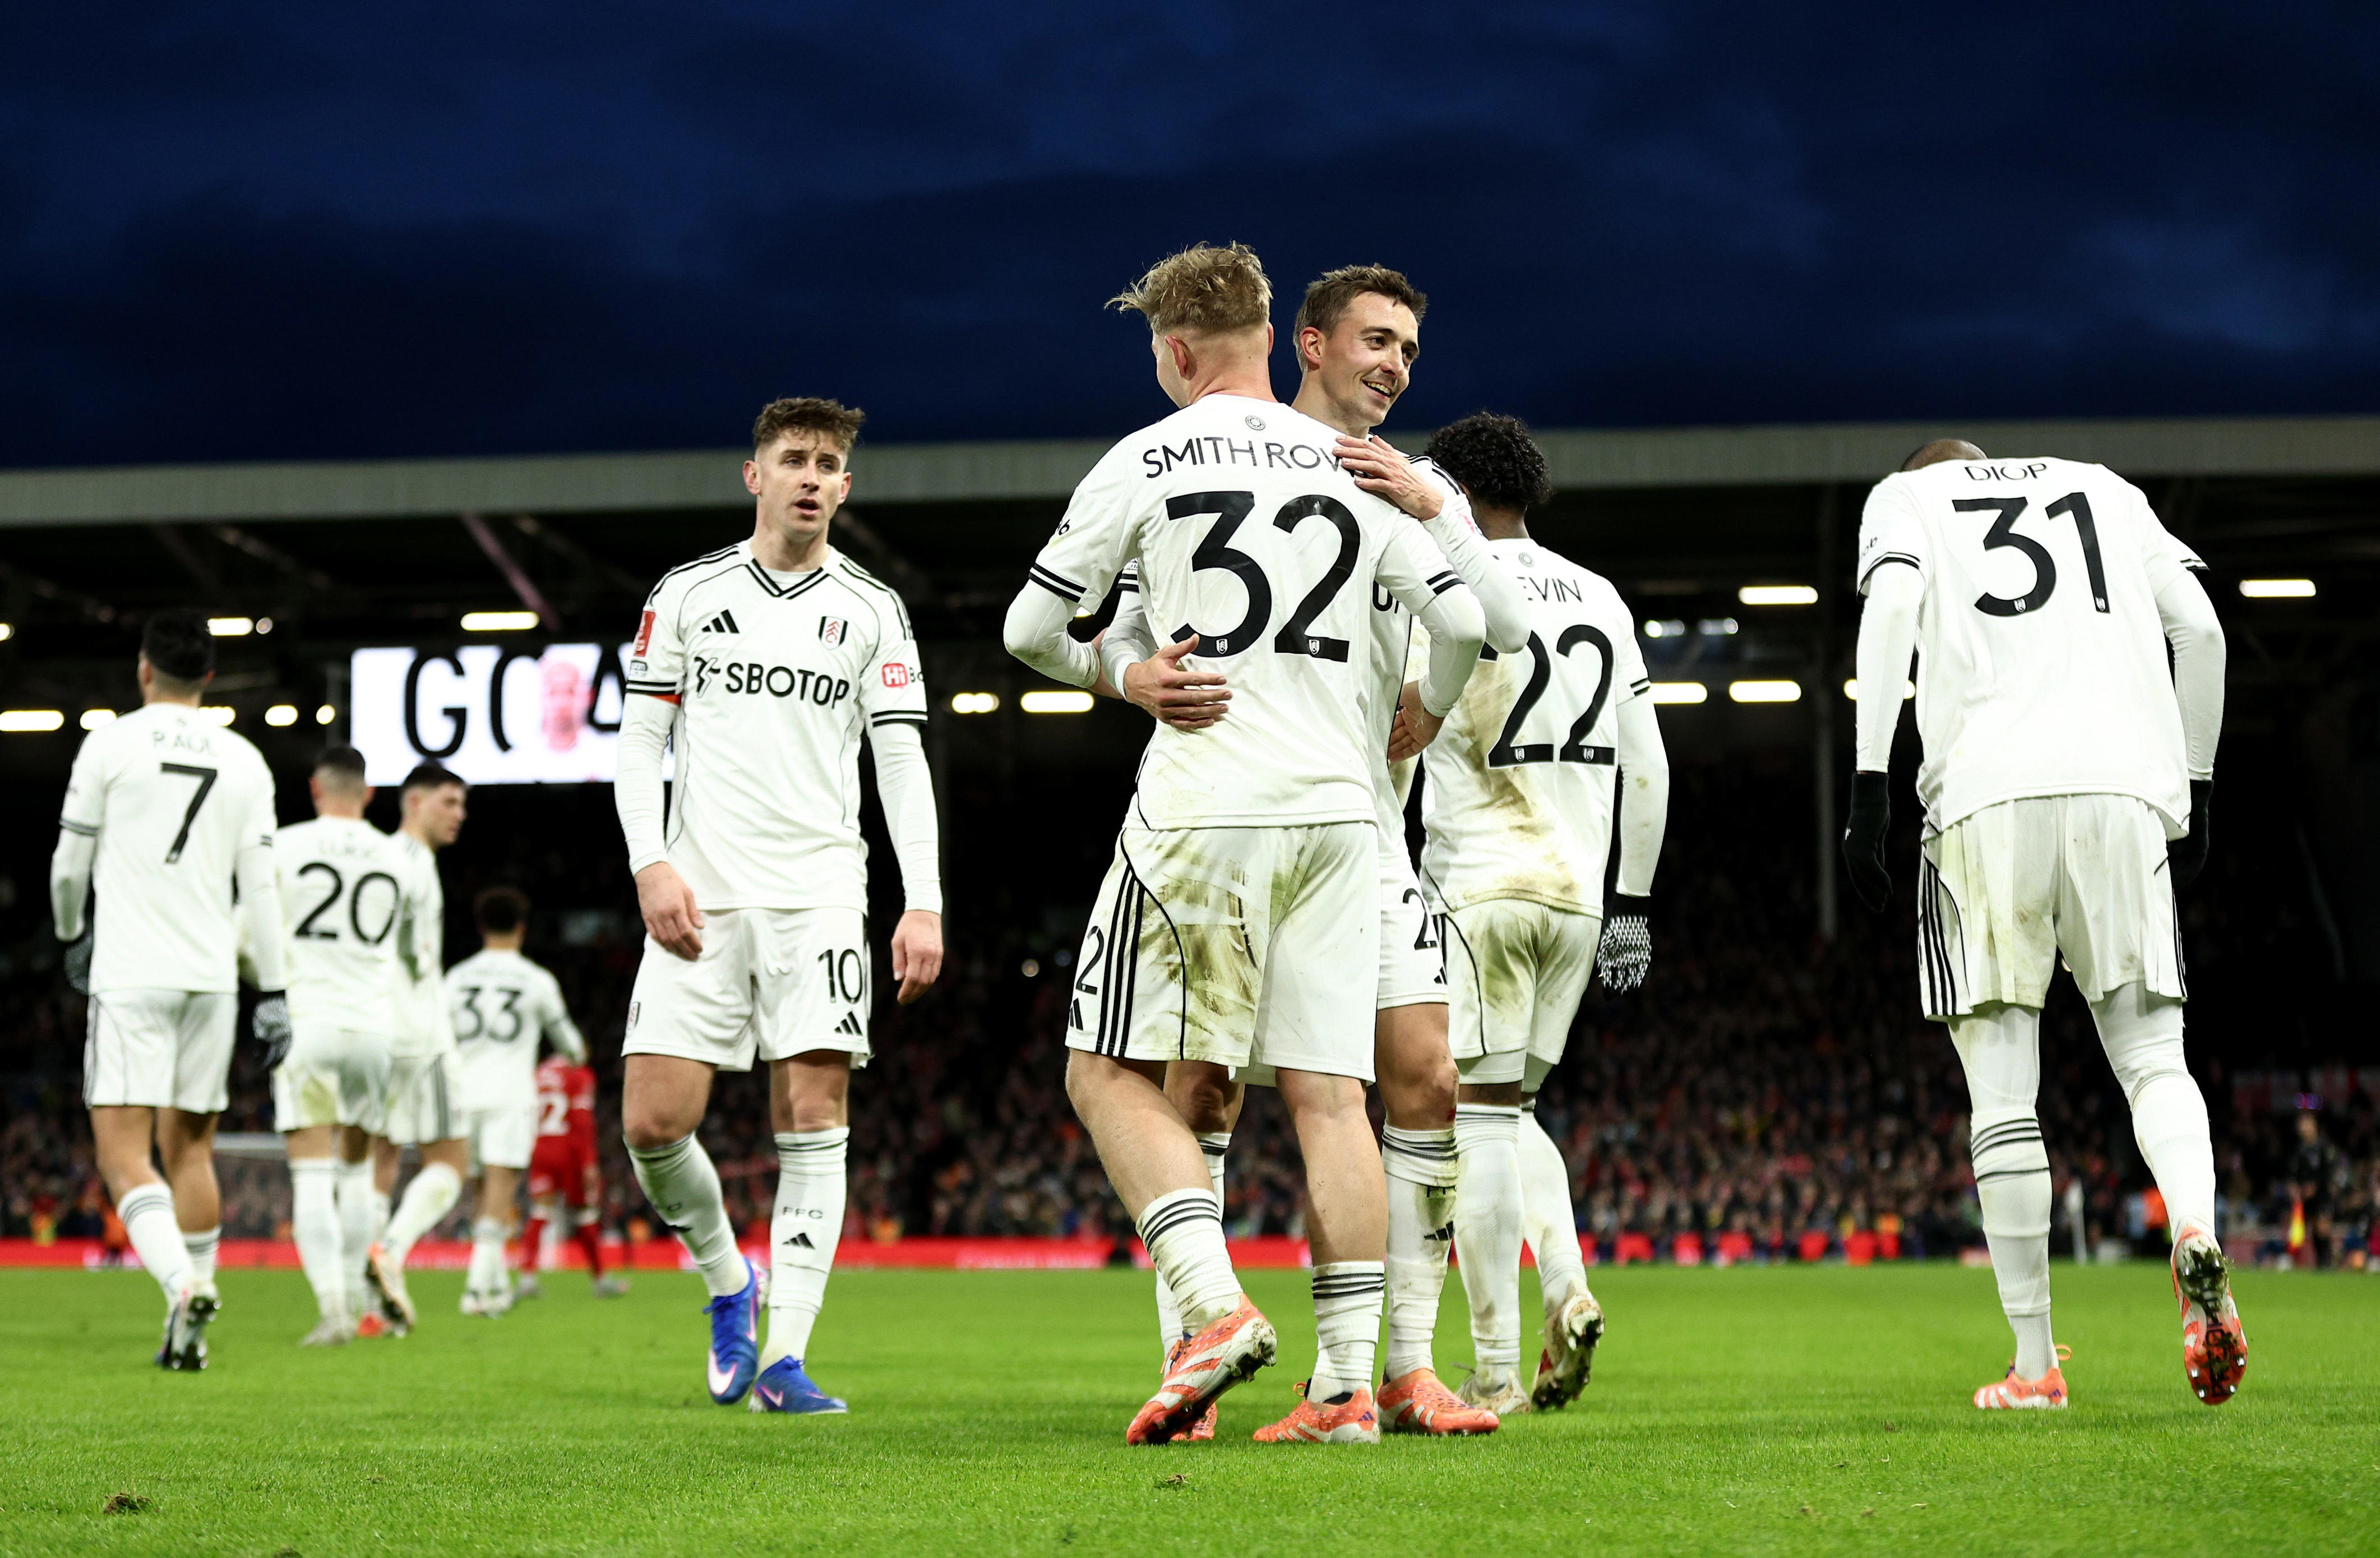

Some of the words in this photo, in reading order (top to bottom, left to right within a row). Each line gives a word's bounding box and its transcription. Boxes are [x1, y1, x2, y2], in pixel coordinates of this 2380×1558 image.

[1143, 437, 1258, 478] SMITH
[1265, 442, 1371, 478] ROW
[1964, 463, 2048, 481] DIOP
[1166, 491, 1360, 662] 32
[1952, 492, 2110, 617] 31
[1517, 576, 1583, 603] VIN
[725, 662, 849, 710] SBOTOP
[884, 665, 907, 686] Hi
[1480, 623, 1615, 768] 22
[160, 762, 218, 864] 7
[295, 861, 400, 946] 20
[817, 949, 863, 1004] 10
[457, 985, 523, 1043] 33
[783, 1206, 823, 1219] FFC
